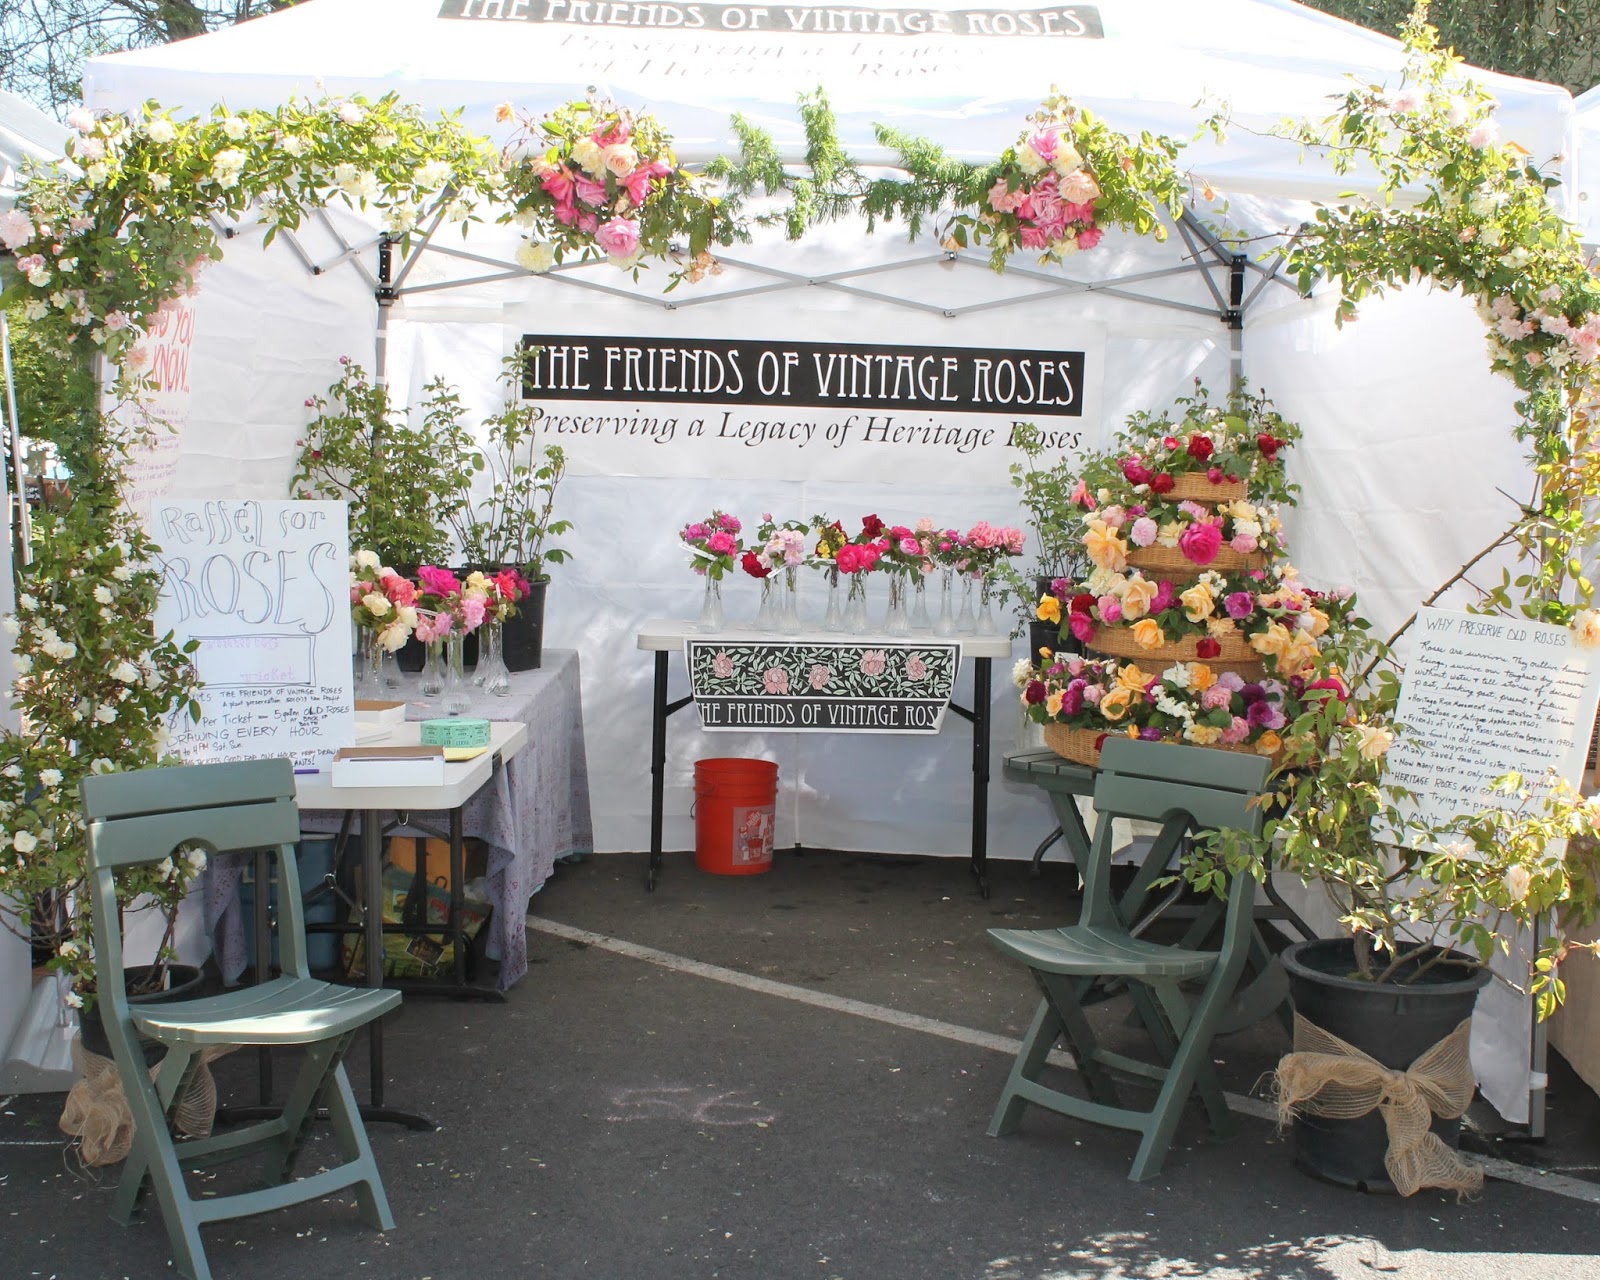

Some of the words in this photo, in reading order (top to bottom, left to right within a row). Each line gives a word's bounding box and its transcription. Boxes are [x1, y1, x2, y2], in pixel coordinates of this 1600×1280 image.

[460, 0, 528, 20] THE
[543, 1, 704, 28] FRIENDS
[720, 8, 768, 29] OF
[784, 9, 953, 34] VINTAGE
[966, 10, 1086, 36] ROSES
[529, 345, 591, 391] THE
[604, 347, 744, 395] FRIENDS
[757, 350, 800, 396] OF
[813, 353, 959, 402] VINTAGE
[972, 358, 1074, 406] ROSES
[524, 405, 680, 445] Preserving
[687, 418, 706, 437] a
[716, 411, 817, 448] Legacy
[826, 415, 859, 449] of
[861, 416, 995, 454] Heritage
[279, 509, 326, 538] for
[164, 541, 337, 634] ROSES
[1426, 617, 1454, 631] WHY
[1458, 619, 1504, 638] PRESERVE
[1506, 628, 1527, 641] OLD
[1533, 630, 1567, 646] ROSES
[1449, 648, 1463, 656] are
[1512, 656, 1528, 671] They
[219, 690, 236, 698] THE
[320, 686, 343, 694] ROSES
[1534, 685, 1545, 698] of
[274, 709, 281, 719] 5
[304, 706, 323, 715] OLD
[326, 705, 350, 714] ROSES
[698, 702, 721, 724] HE
[727, 703, 796, 725] FRIENDS
[801, 703, 822, 725] OF
[828, 704, 899, 726] VINTAGE
[167, 729, 229, 747] DRAWING
[237, 726, 278, 738] EVERY
[289, 726, 323, 737] HOUR
[1408, 713, 1434, 726] Friends
[1436, 718, 1446, 727] of
[1447, 721, 1474, 736] Vintage
[1458, 735, 1470, 743] old
[183, 748, 191, 756] to
[277, 751, 297, 759] HOUR
[1401, 744, 1426, 758] Many
[1430, 751, 1454, 760] saved
[1474, 758, 1487, 766] old
[1489, 760, 1506, 770] sites
[1517, 762, 1545, 775] Sonoma
[1399, 758, 1414, 767] Now
[1416, 761, 1434, 773] many
[1435, 765, 1456, 774] exist
[1466, 768, 1484, 782] only
[1394, 771, 1430, 786] HERITAGE
[1434, 778, 1458, 790] ROSES
[1460, 784, 1478, 793] MAY
[1479, 787, 1492, 796] GO
